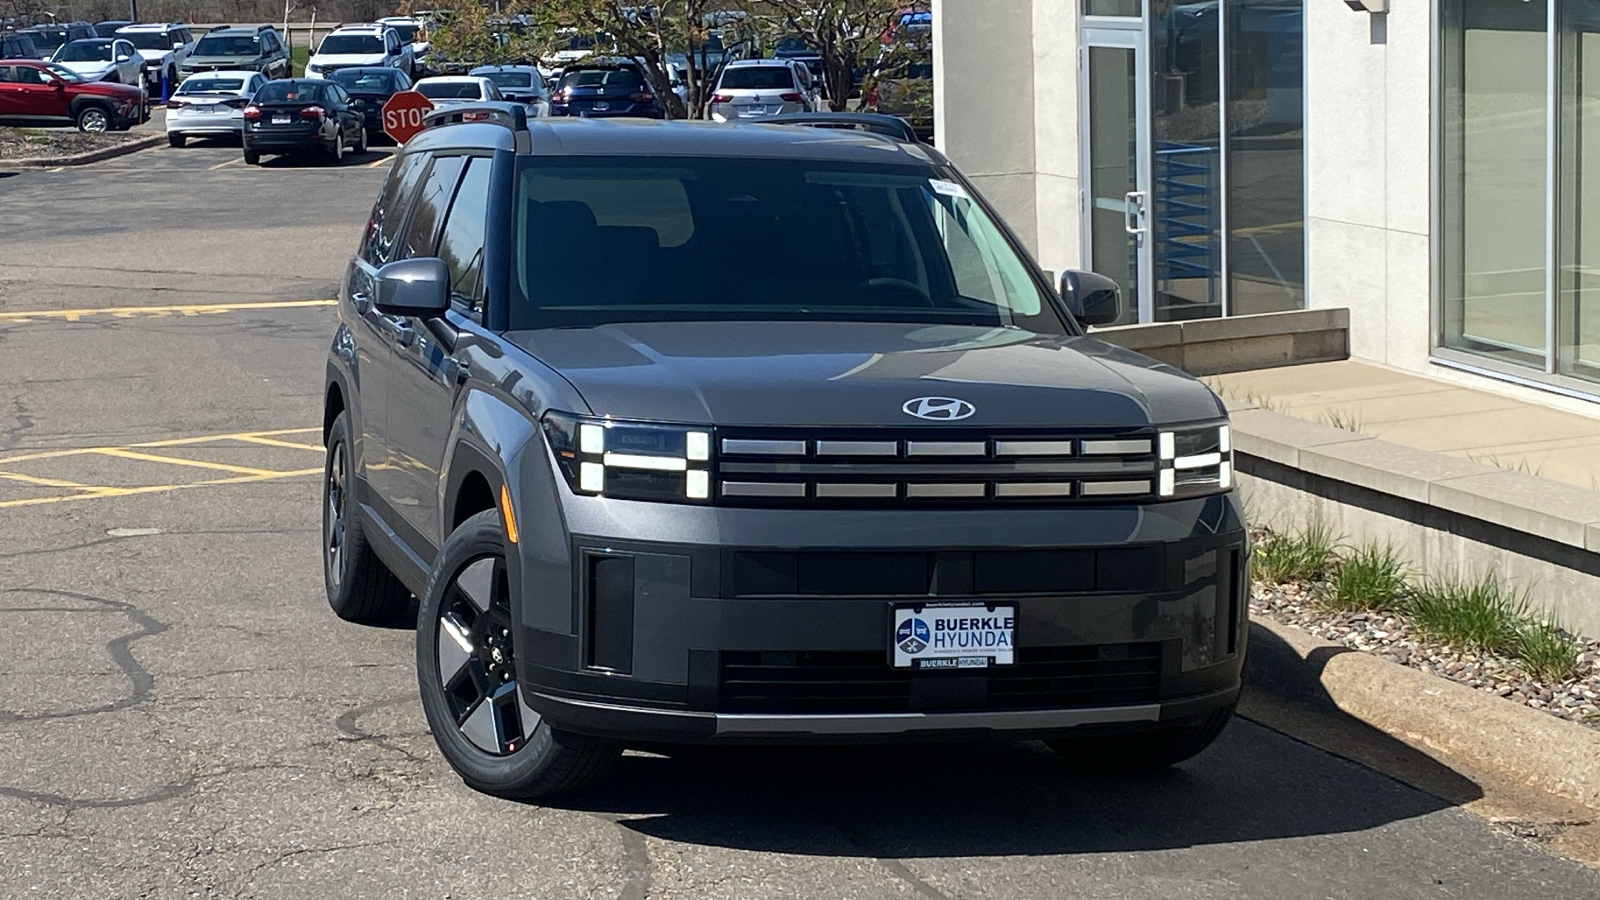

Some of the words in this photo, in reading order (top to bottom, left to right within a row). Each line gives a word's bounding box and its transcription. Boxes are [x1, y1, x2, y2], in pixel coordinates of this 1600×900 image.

[935, 617, 1014, 631] BUERKLE
[934, 631, 1014, 648] HYUNDAI
[920, 659, 957, 667] BUERKLE
